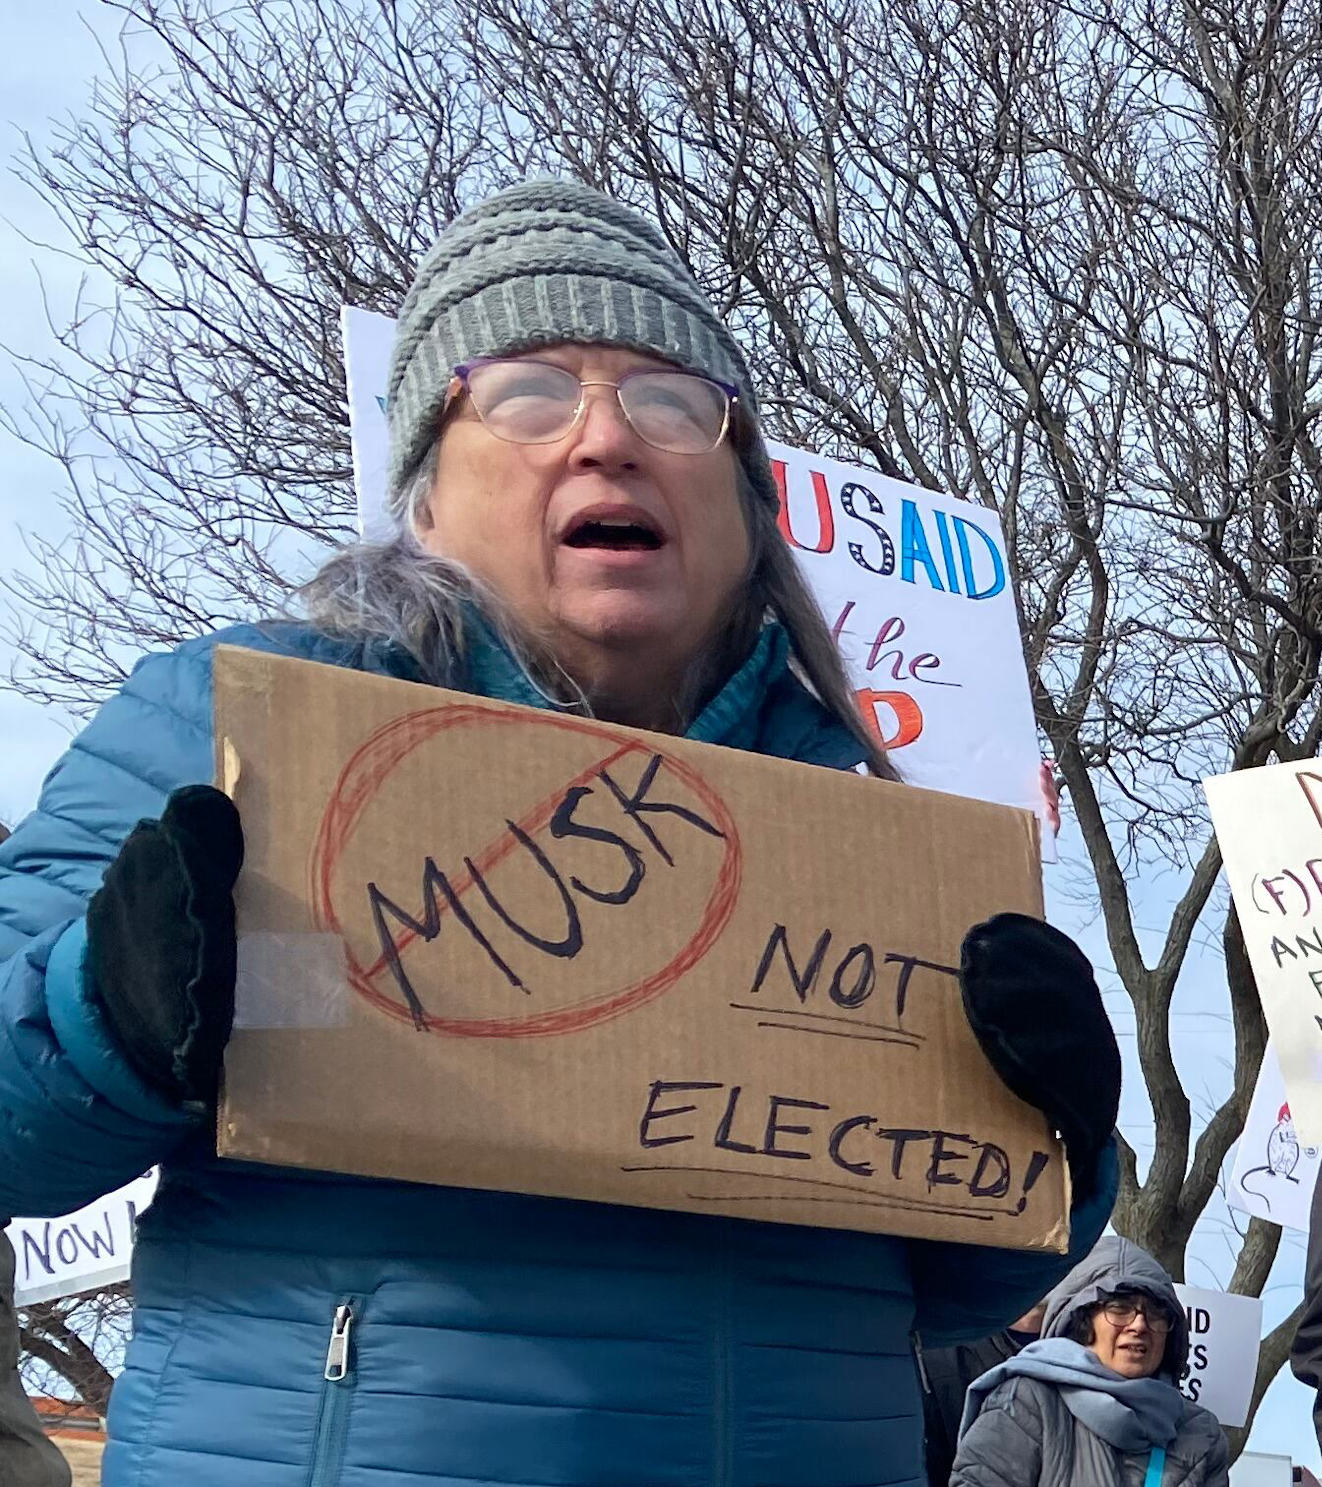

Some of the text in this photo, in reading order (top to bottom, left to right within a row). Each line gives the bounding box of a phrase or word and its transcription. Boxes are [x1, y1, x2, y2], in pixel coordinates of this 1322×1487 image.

[771, 459, 1007, 600] USAID
[366, 754, 725, 1033] MUSK
[747, 924, 962, 1022] NOT
[637, 1080, 1050, 1217] ELECTED!
